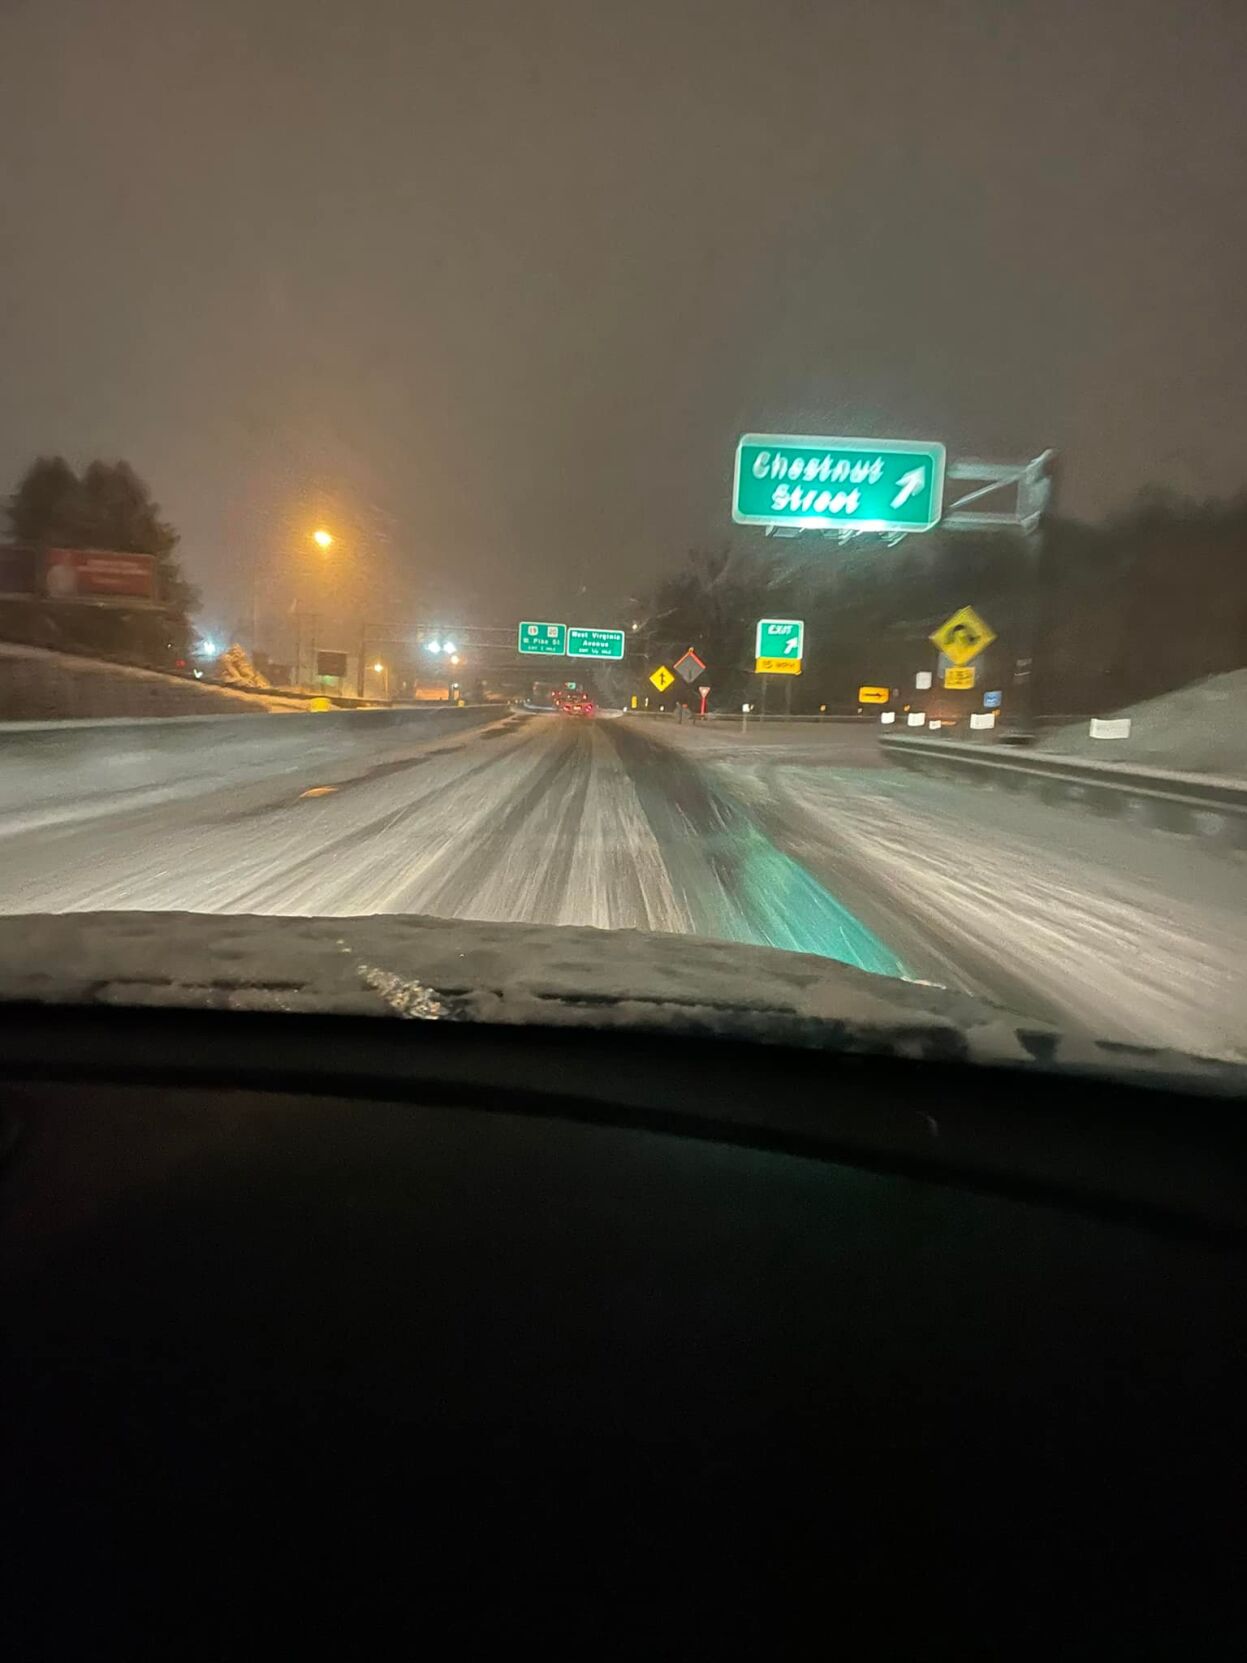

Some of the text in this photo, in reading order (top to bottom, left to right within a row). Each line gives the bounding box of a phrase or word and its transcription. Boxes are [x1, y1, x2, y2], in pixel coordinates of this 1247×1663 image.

[752, 451, 884, 484] Chestnut
[771, 483, 861, 514] Street
[592, 632, 621, 640] Virginia
